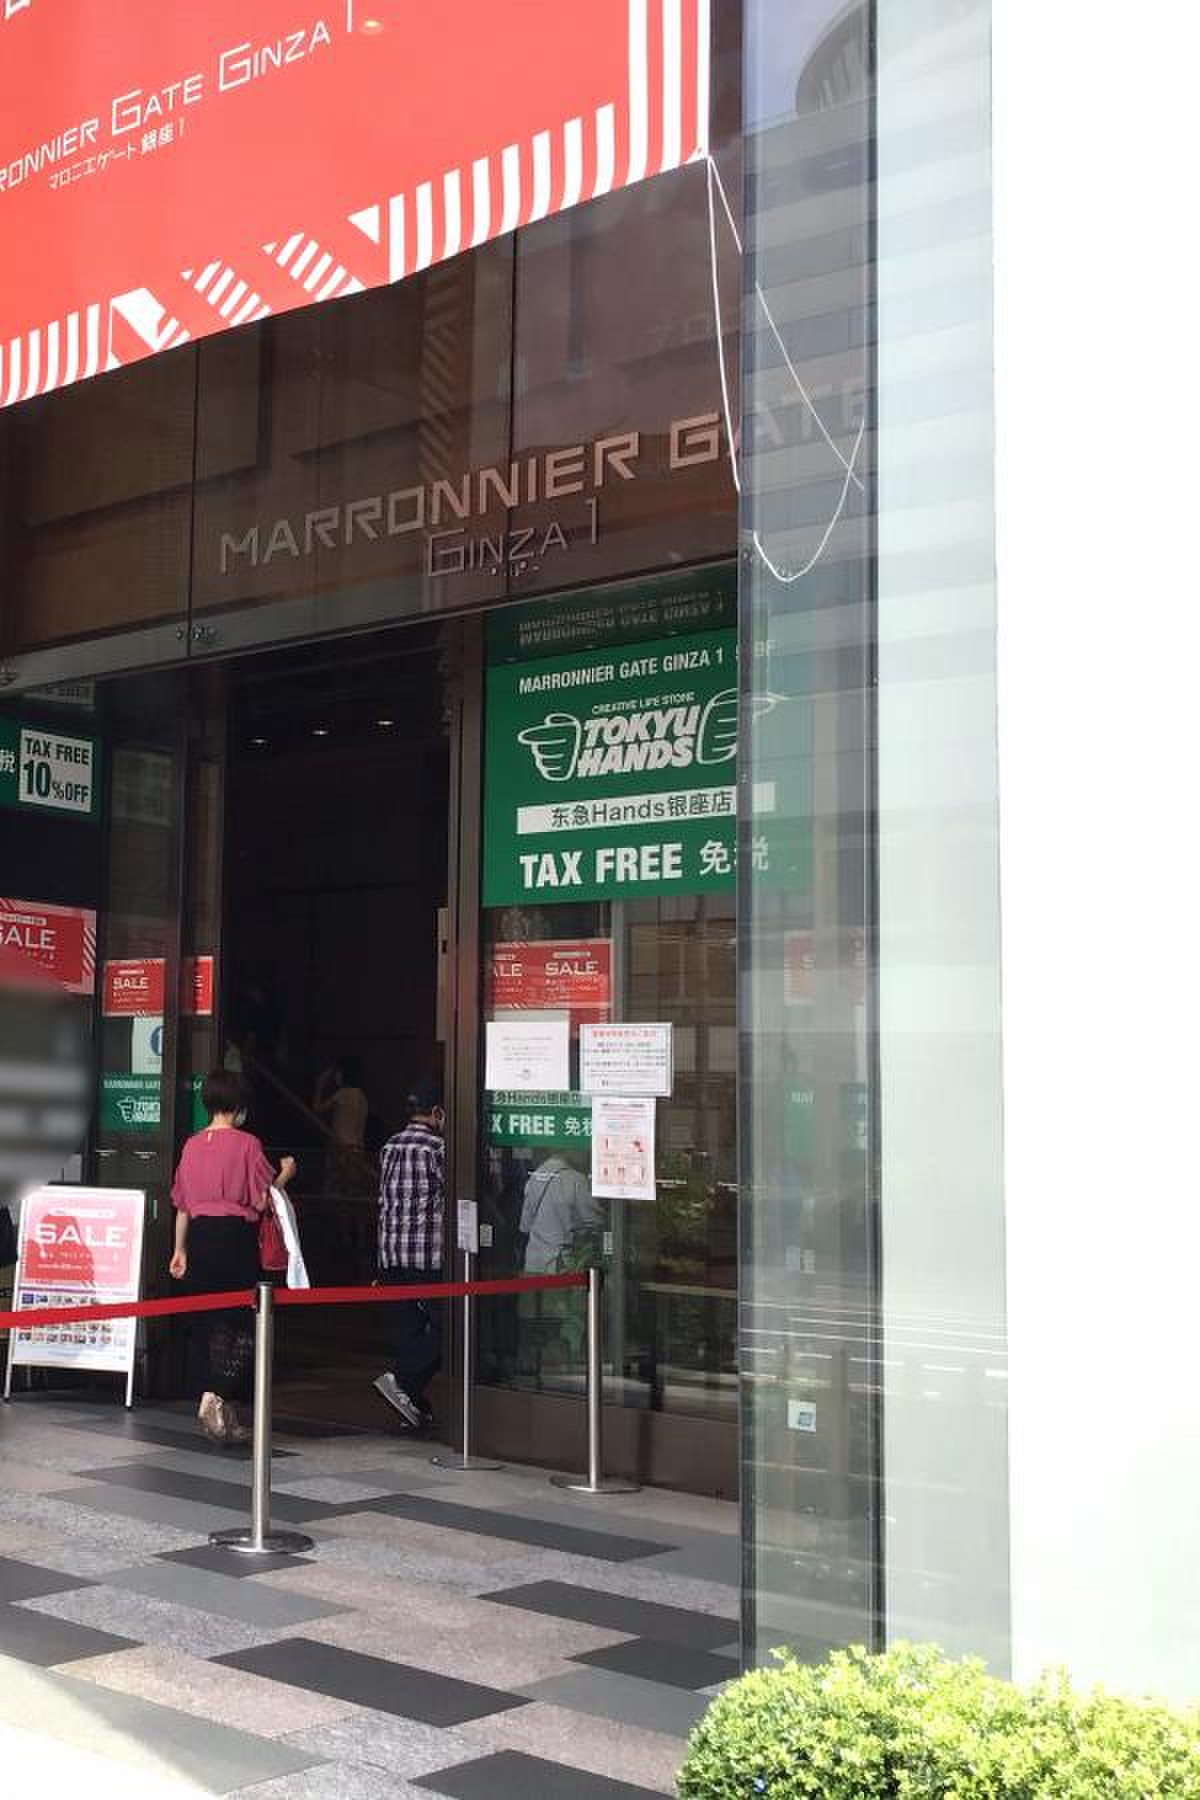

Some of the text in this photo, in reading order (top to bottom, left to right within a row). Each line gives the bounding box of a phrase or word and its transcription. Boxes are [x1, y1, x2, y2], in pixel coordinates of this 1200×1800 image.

[111, 73, 204, 136] GATE
[218, 19, 331, 92] GINZA
[219, 430, 642, 574] MARRONNIER
[427, 495, 598, 577] GINZA 1
[518, 664, 615, 695] MARRONNIER
[618, 656, 659, 680] GATE
[662, 649, 711, 673] GINZA
[715, 647, 724, 664] 1
[583, 704, 702, 747] TOKYU
[24, 737, 90, 766] TAX FREE
[576, 736, 695, 778] HANDS
[551, 790, 734, 829] 东急Hands银座店
[519, 842, 683, 889] TAX FREE
[112, 977, 149, 990] SALE
[544, 960, 599, 977] SALE
[509, 1114, 556, 1136] FREE
[34, 1222, 128, 1248] SALE
